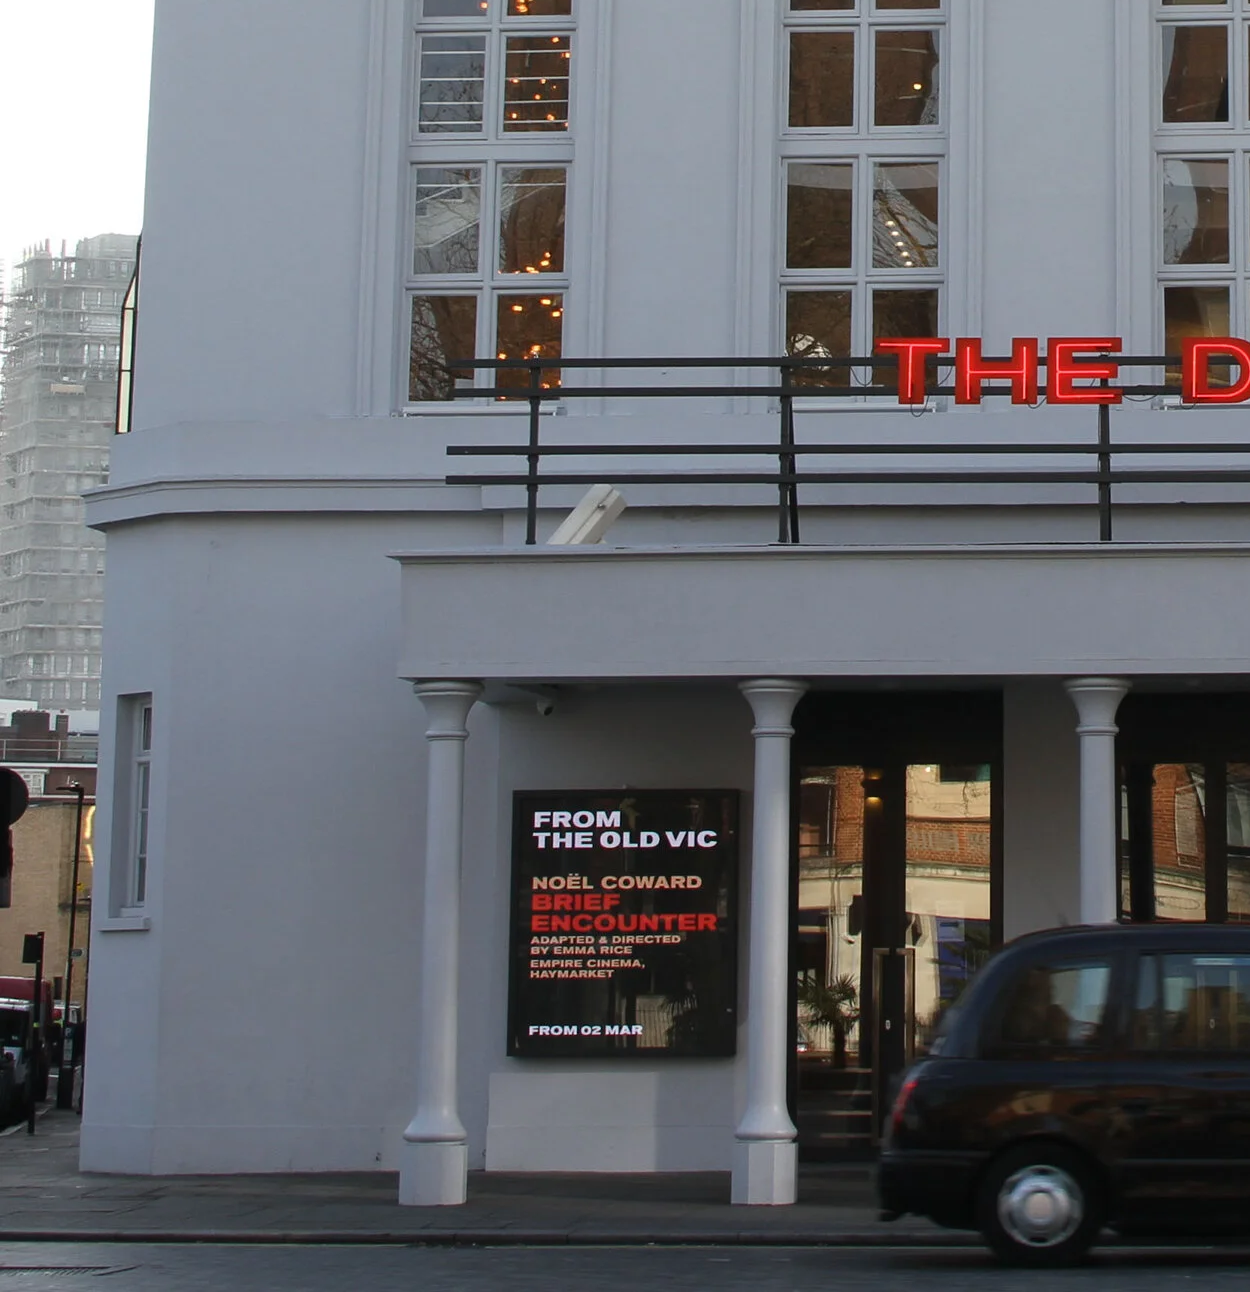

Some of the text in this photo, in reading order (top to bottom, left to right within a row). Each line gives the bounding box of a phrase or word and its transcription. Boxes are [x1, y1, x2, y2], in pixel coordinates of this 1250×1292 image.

[874, 336, 1124, 405] THE
[533, 811, 621, 828] FROM
[532, 830, 718, 849] THE OLD VIC
[532, 873, 702, 890] NOËL COWARD
[531, 893, 621, 911] BRIEF
[531, 914, 718, 932] ENCOUNTER
[530, 934, 682, 945] ADAPTED & DIRECTED
[530, 945, 633, 955] BY EMMA RICE
[530, 959, 646, 969] EMPIRE CINEMA,
[529, 969, 615, 979] HAYMARKET
[528, 1025, 643, 1036] FROM 02 MAR
